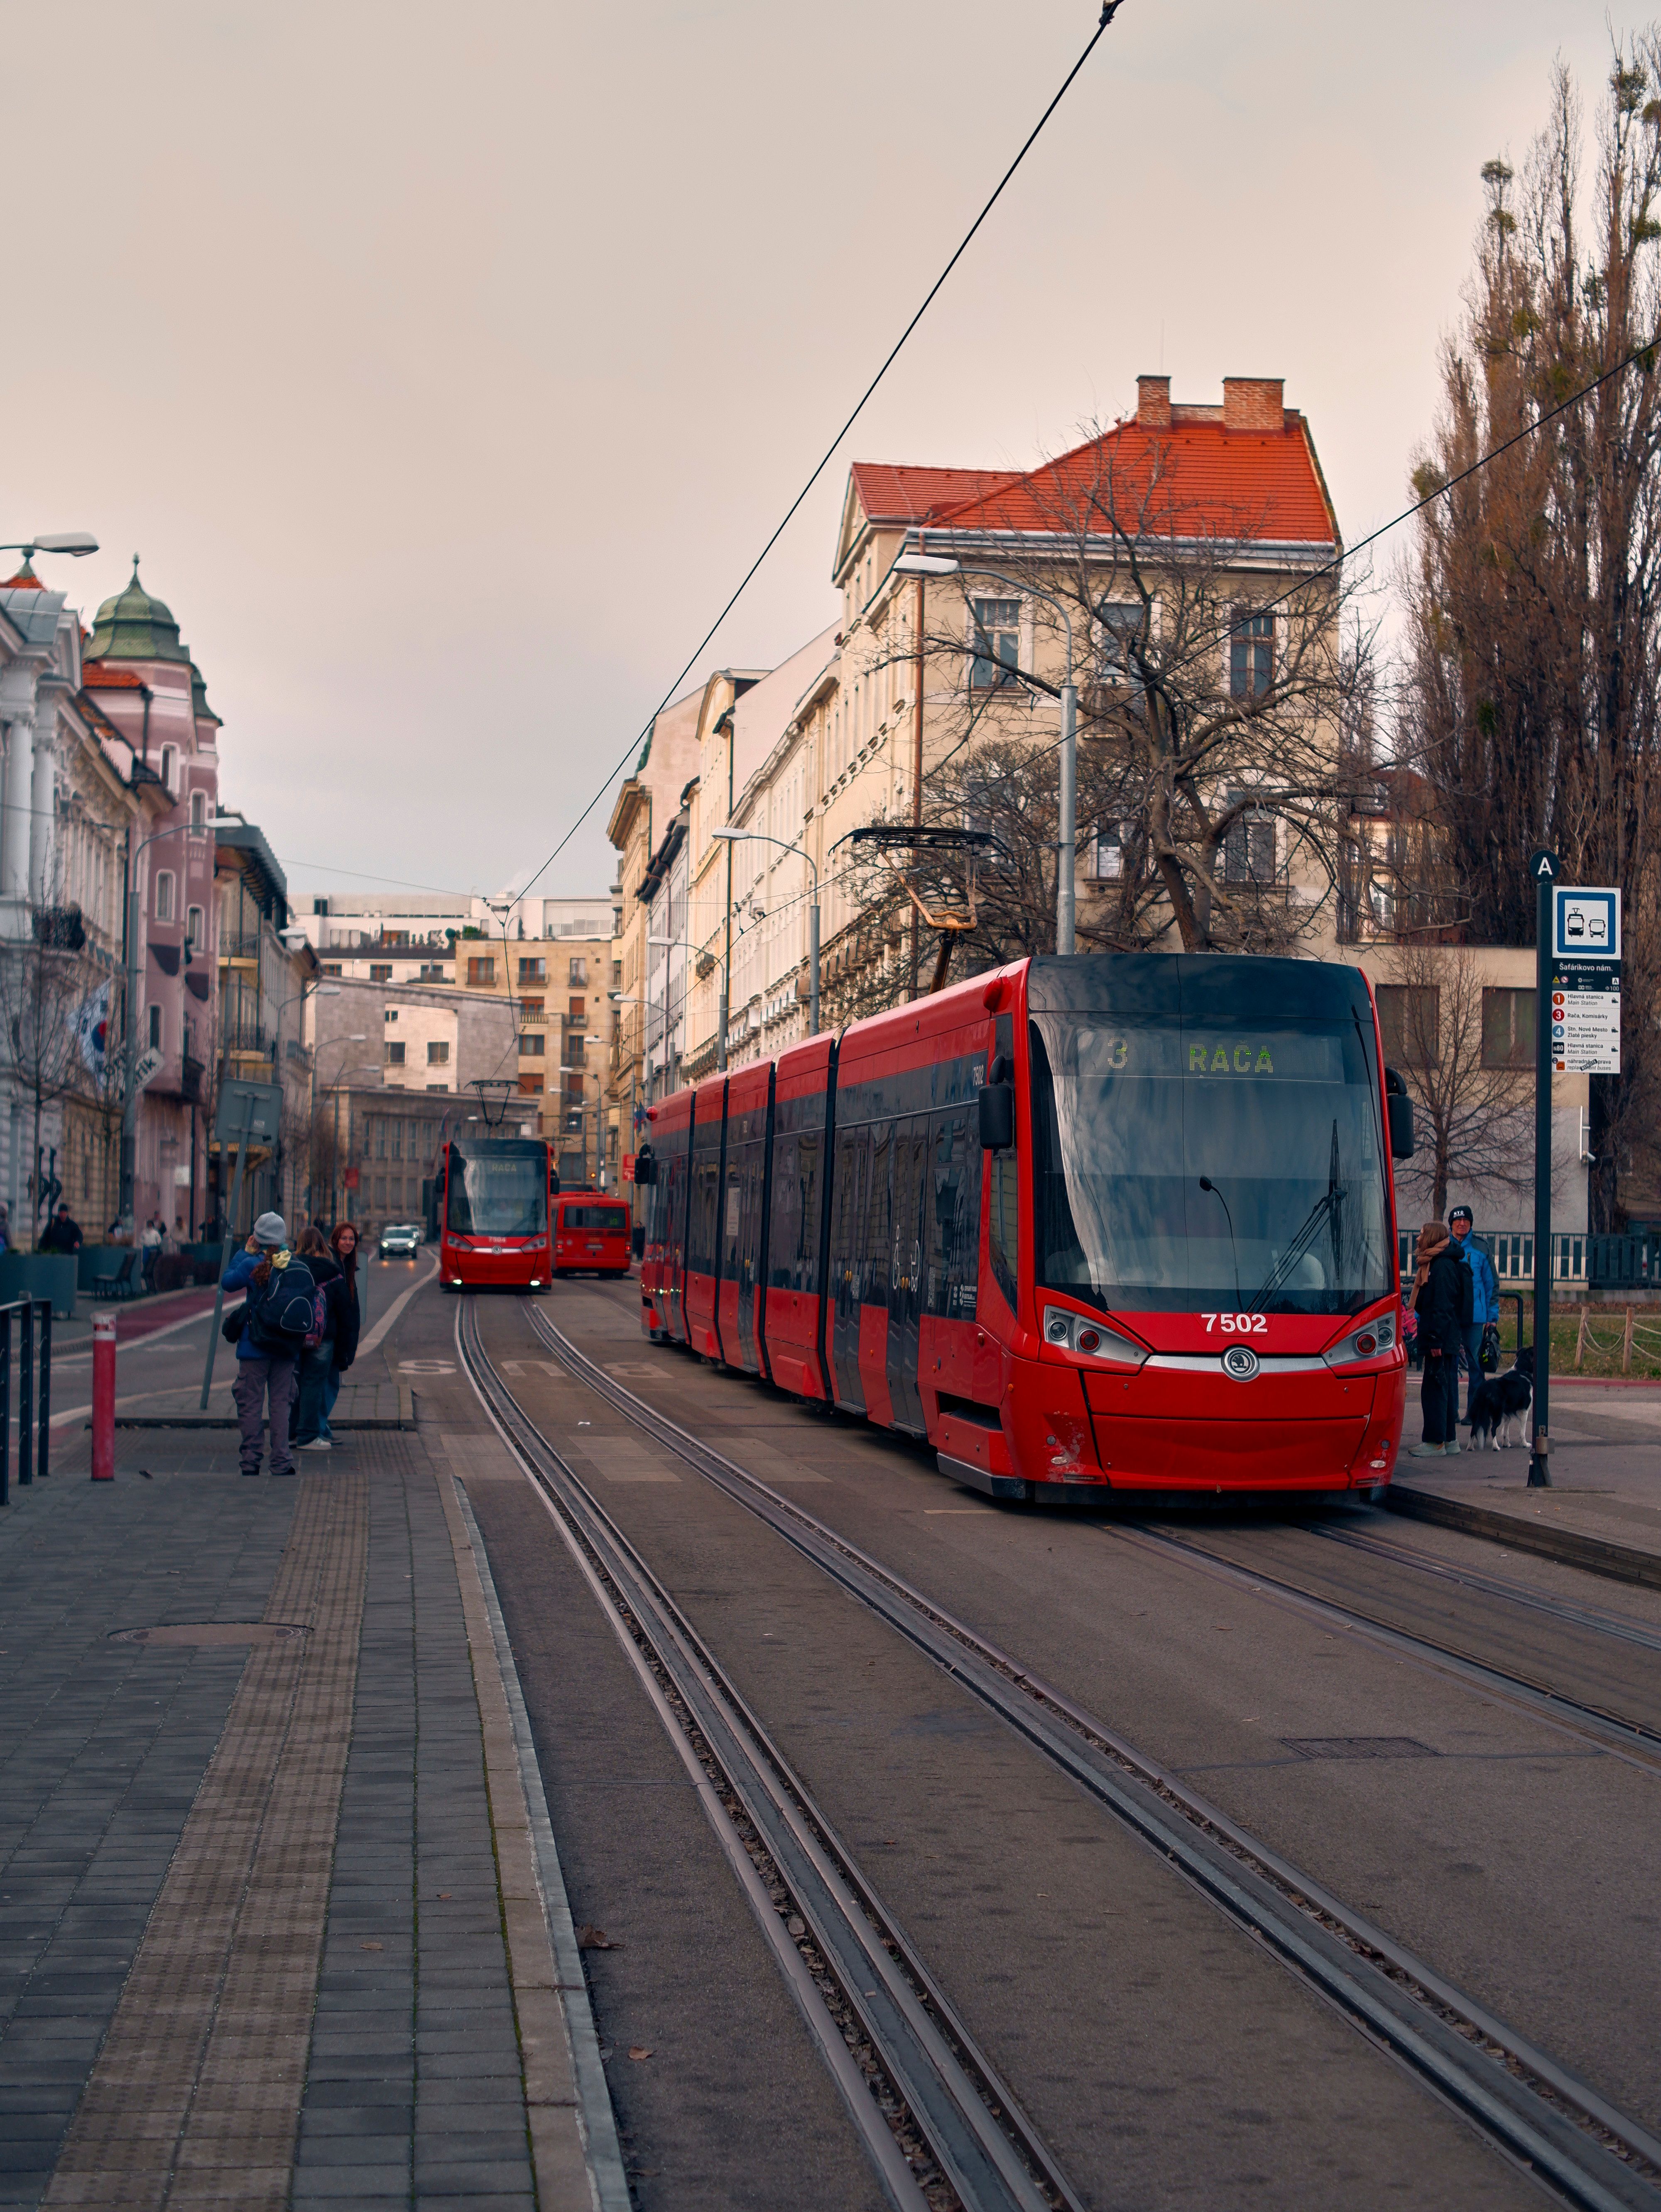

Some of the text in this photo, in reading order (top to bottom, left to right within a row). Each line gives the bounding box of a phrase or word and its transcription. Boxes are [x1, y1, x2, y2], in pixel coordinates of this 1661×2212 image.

[1537, 857, 1553, 875] A
[1559, 962, 1595, 971] Šafárikovo
[1556, 995, 1560, 1003] 1
[1556, 1011, 1561, 1019] 3
[1107, 1037, 1128, 1069] 3
[973, 1064, 984, 1086] 7502
[1201, 1314, 1268, 1332] 7502
